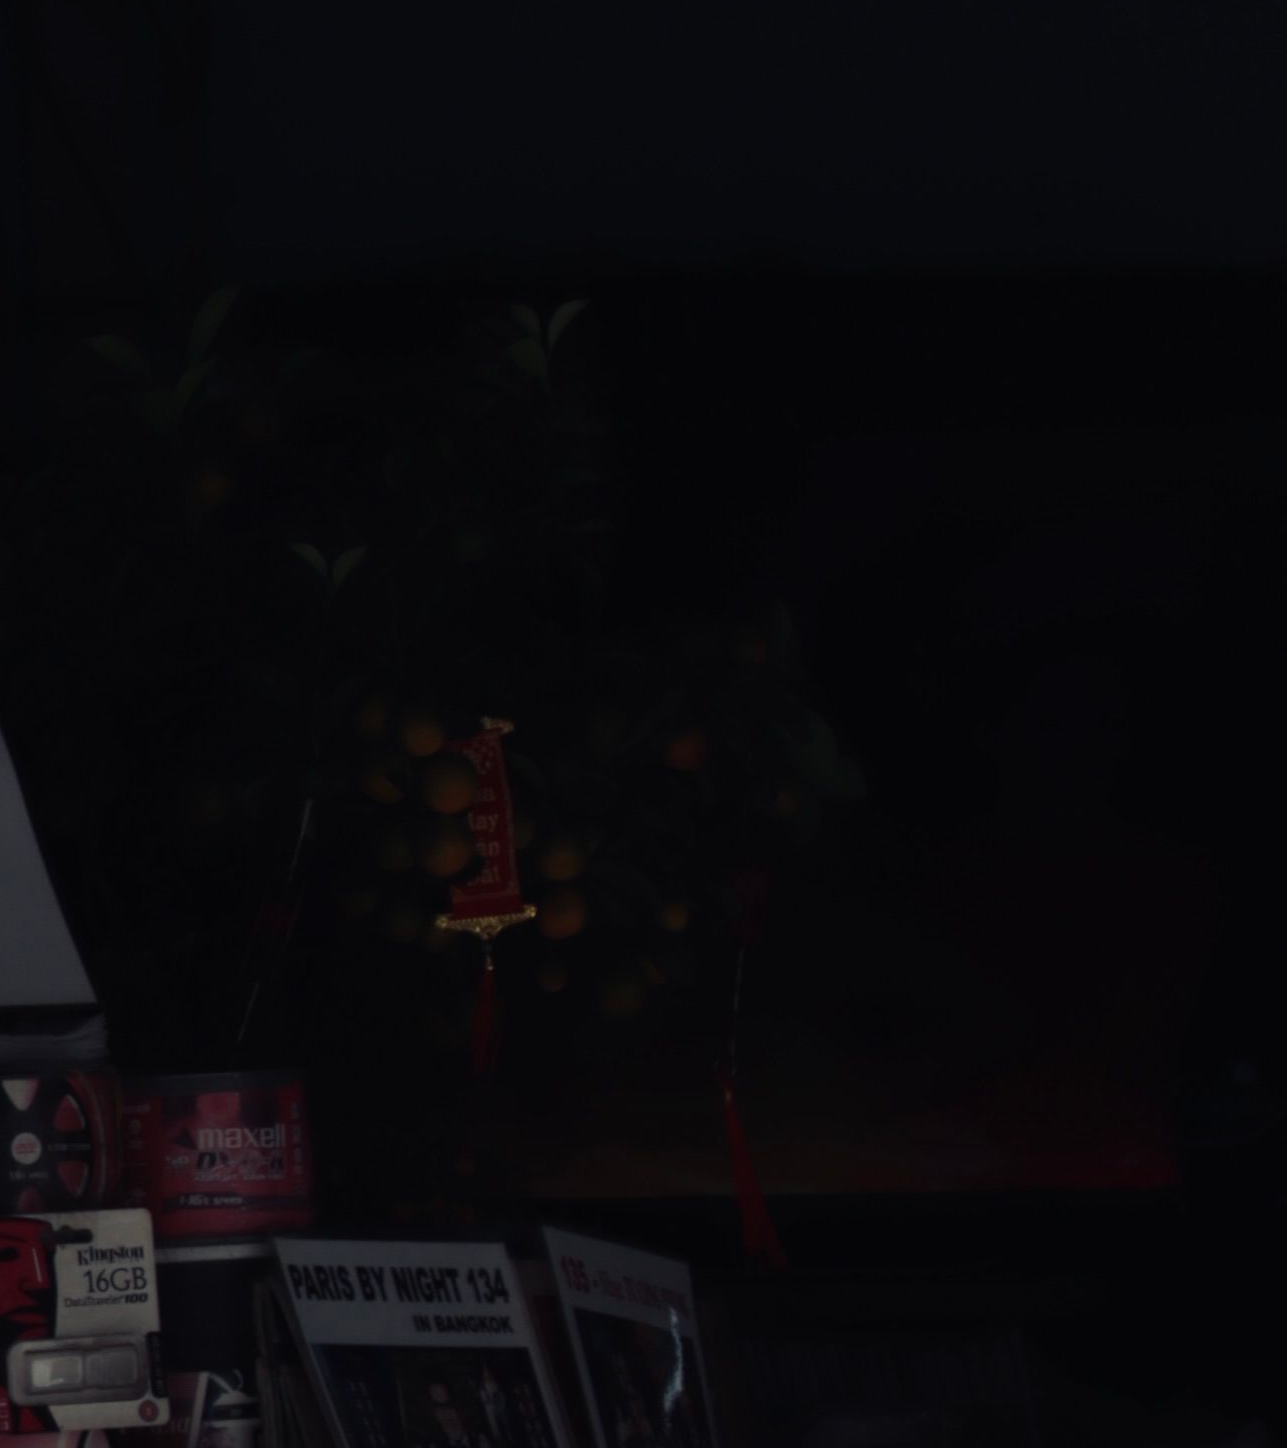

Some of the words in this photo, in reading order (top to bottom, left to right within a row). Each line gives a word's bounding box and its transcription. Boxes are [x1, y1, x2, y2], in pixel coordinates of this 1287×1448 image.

[197, 1123, 287, 1151] maxell
[77, 1246, 145, 1266] Kingston
[85, 1267, 148, 1293] 16GB
[288, 1264, 355, 1302] PARIS
[358, 1265, 387, 1303] BY
[393, 1265, 462, 1304] NIGHT
[467, 1266, 510, 1304] 134
[414, 1313, 431, 1332] IN
[434, 1314, 514, 1335] BANGKOK
